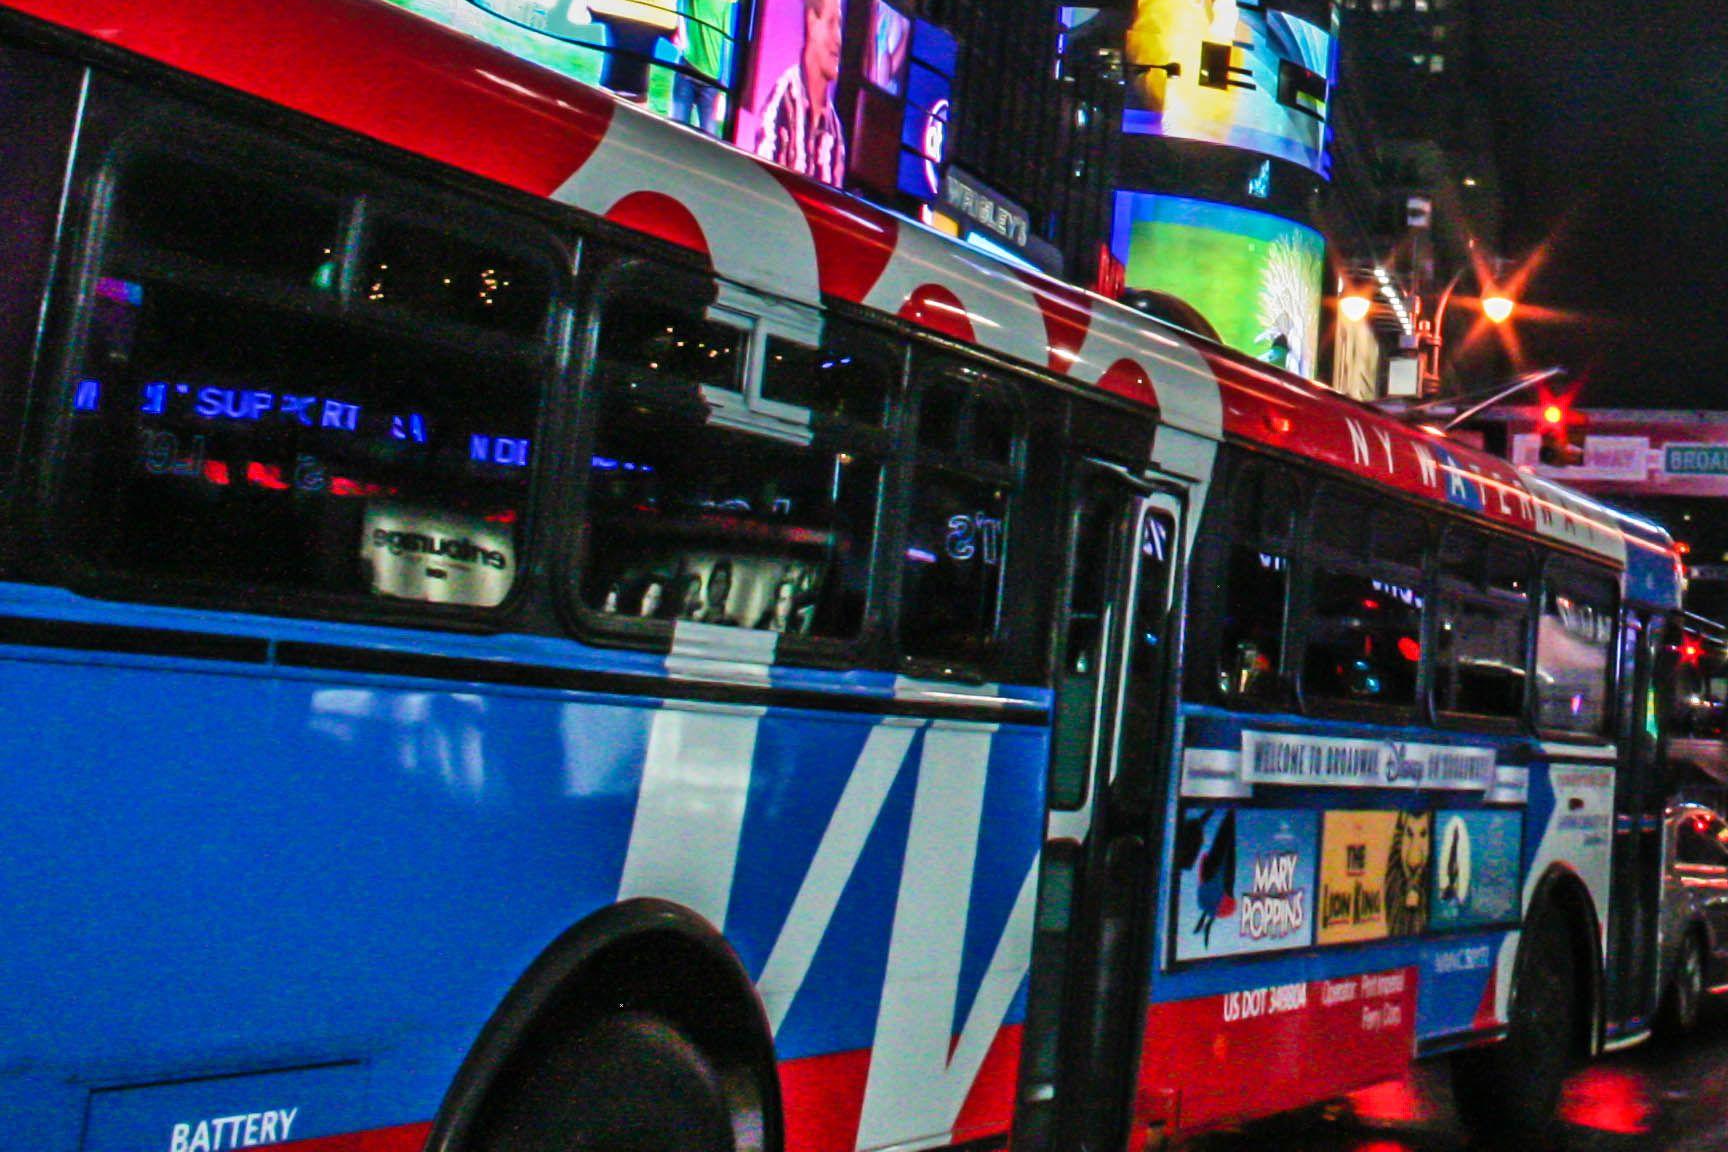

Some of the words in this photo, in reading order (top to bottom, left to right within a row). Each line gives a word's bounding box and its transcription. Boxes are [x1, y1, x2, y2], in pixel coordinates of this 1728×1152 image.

[1253, 740, 1305, 776] WELCOME
[1310, 744, 1323, 777] TO
[1253, 852, 1300, 894] MARY
[1240, 890, 1306, 940] POPPINS
[1223, 992, 1241, 1022] US
[1241, 988, 1268, 1018] DOT
[170, 1108, 298, 1152] BATTERY
